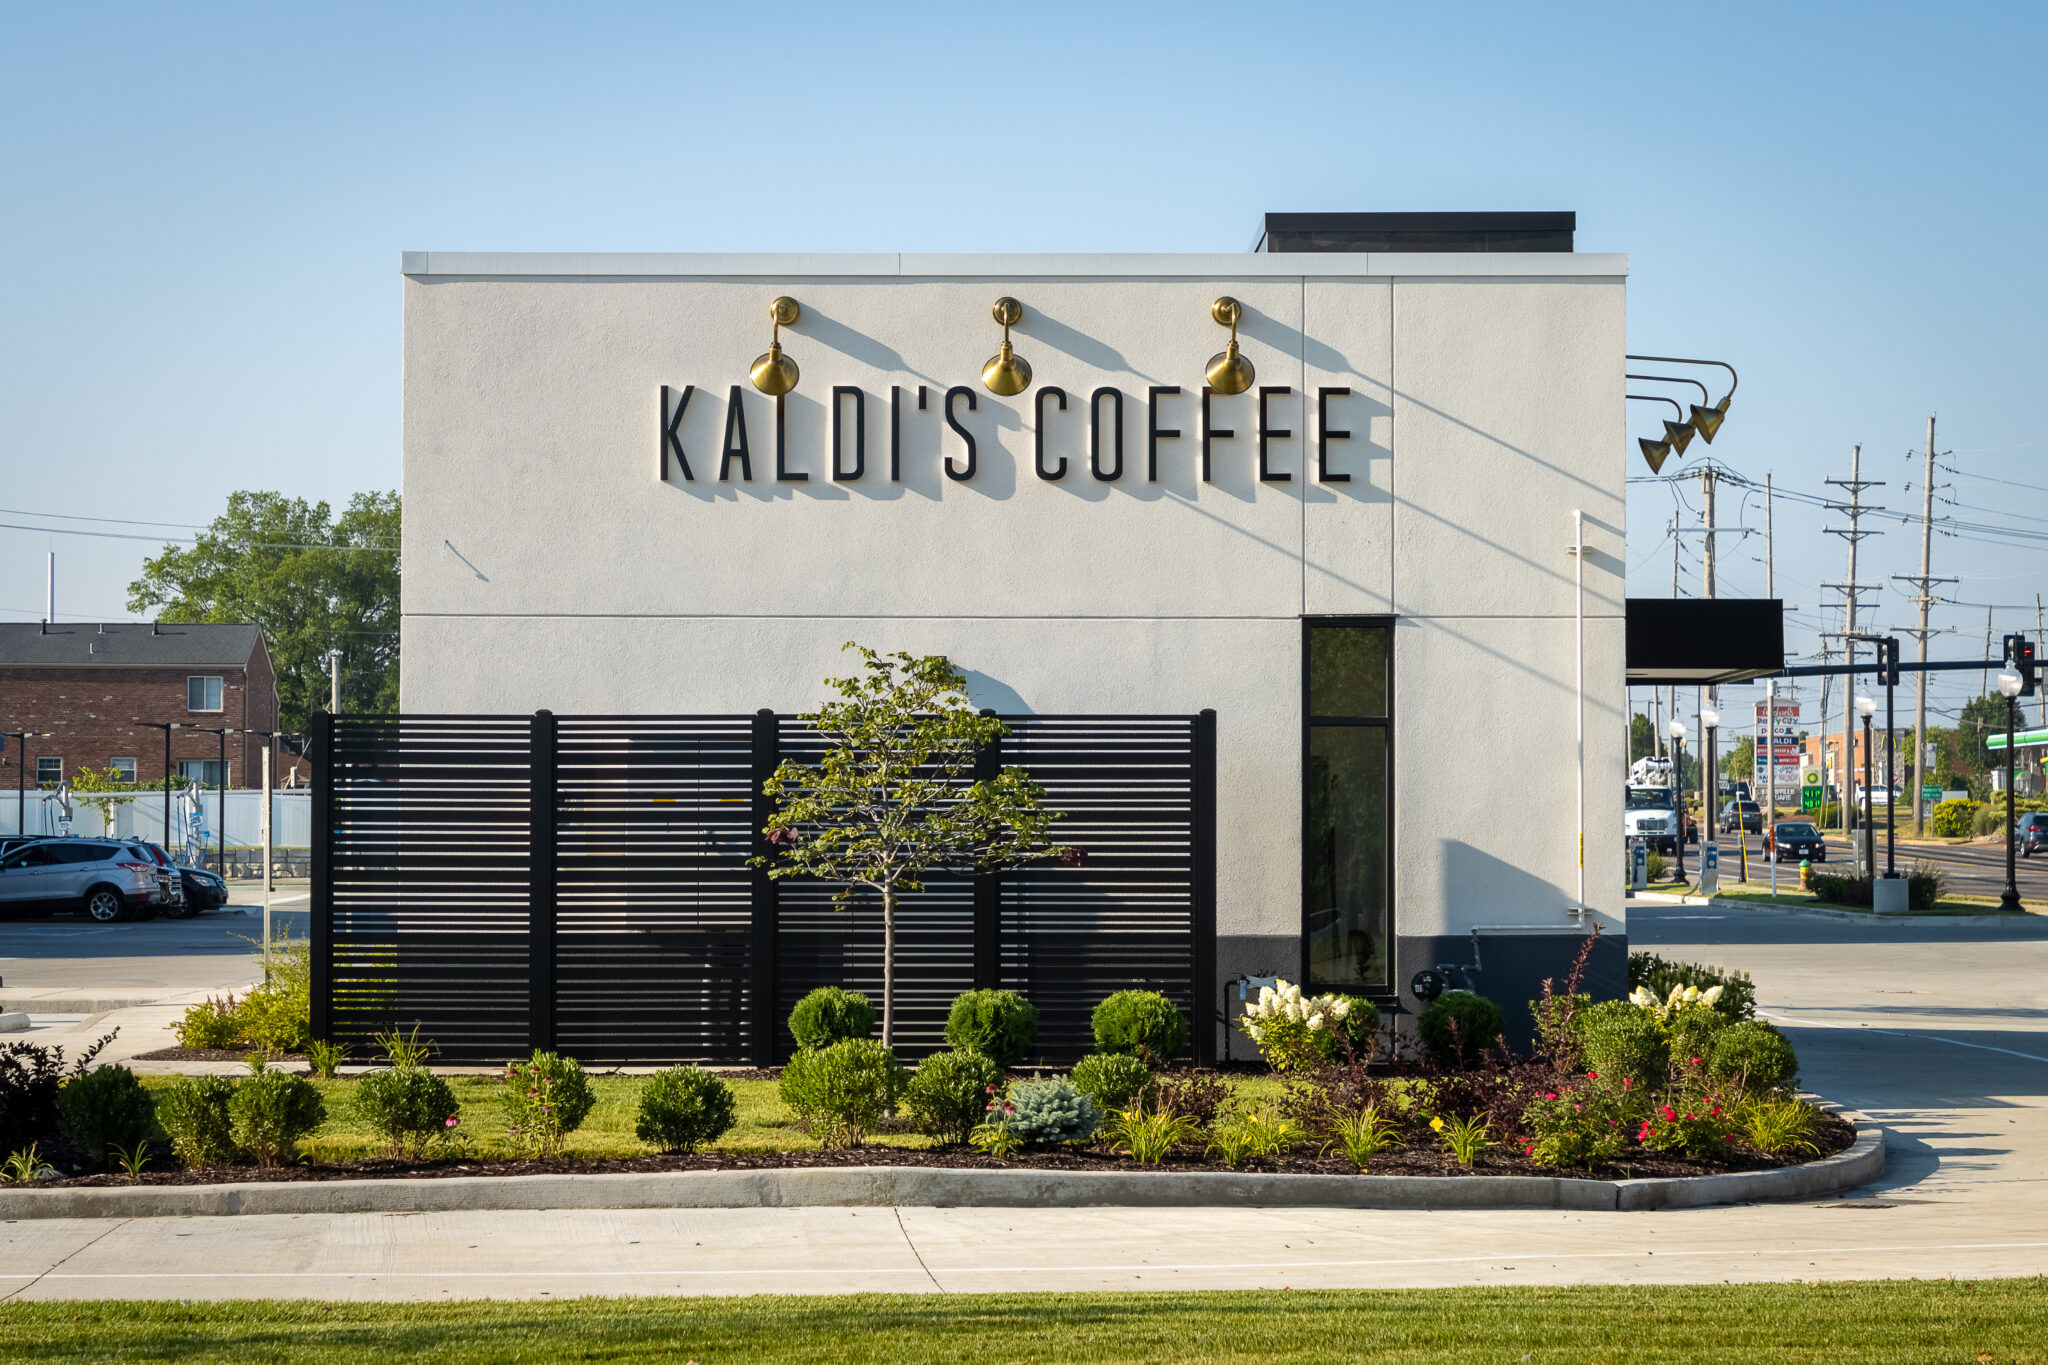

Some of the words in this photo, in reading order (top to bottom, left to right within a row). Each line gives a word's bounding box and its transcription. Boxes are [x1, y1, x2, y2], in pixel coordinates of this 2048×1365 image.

[660, 384, 978, 482] KALDI'S
[1034, 385, 1352, 483] COFFEE
[1757, 717, 1781, 725] Pay
